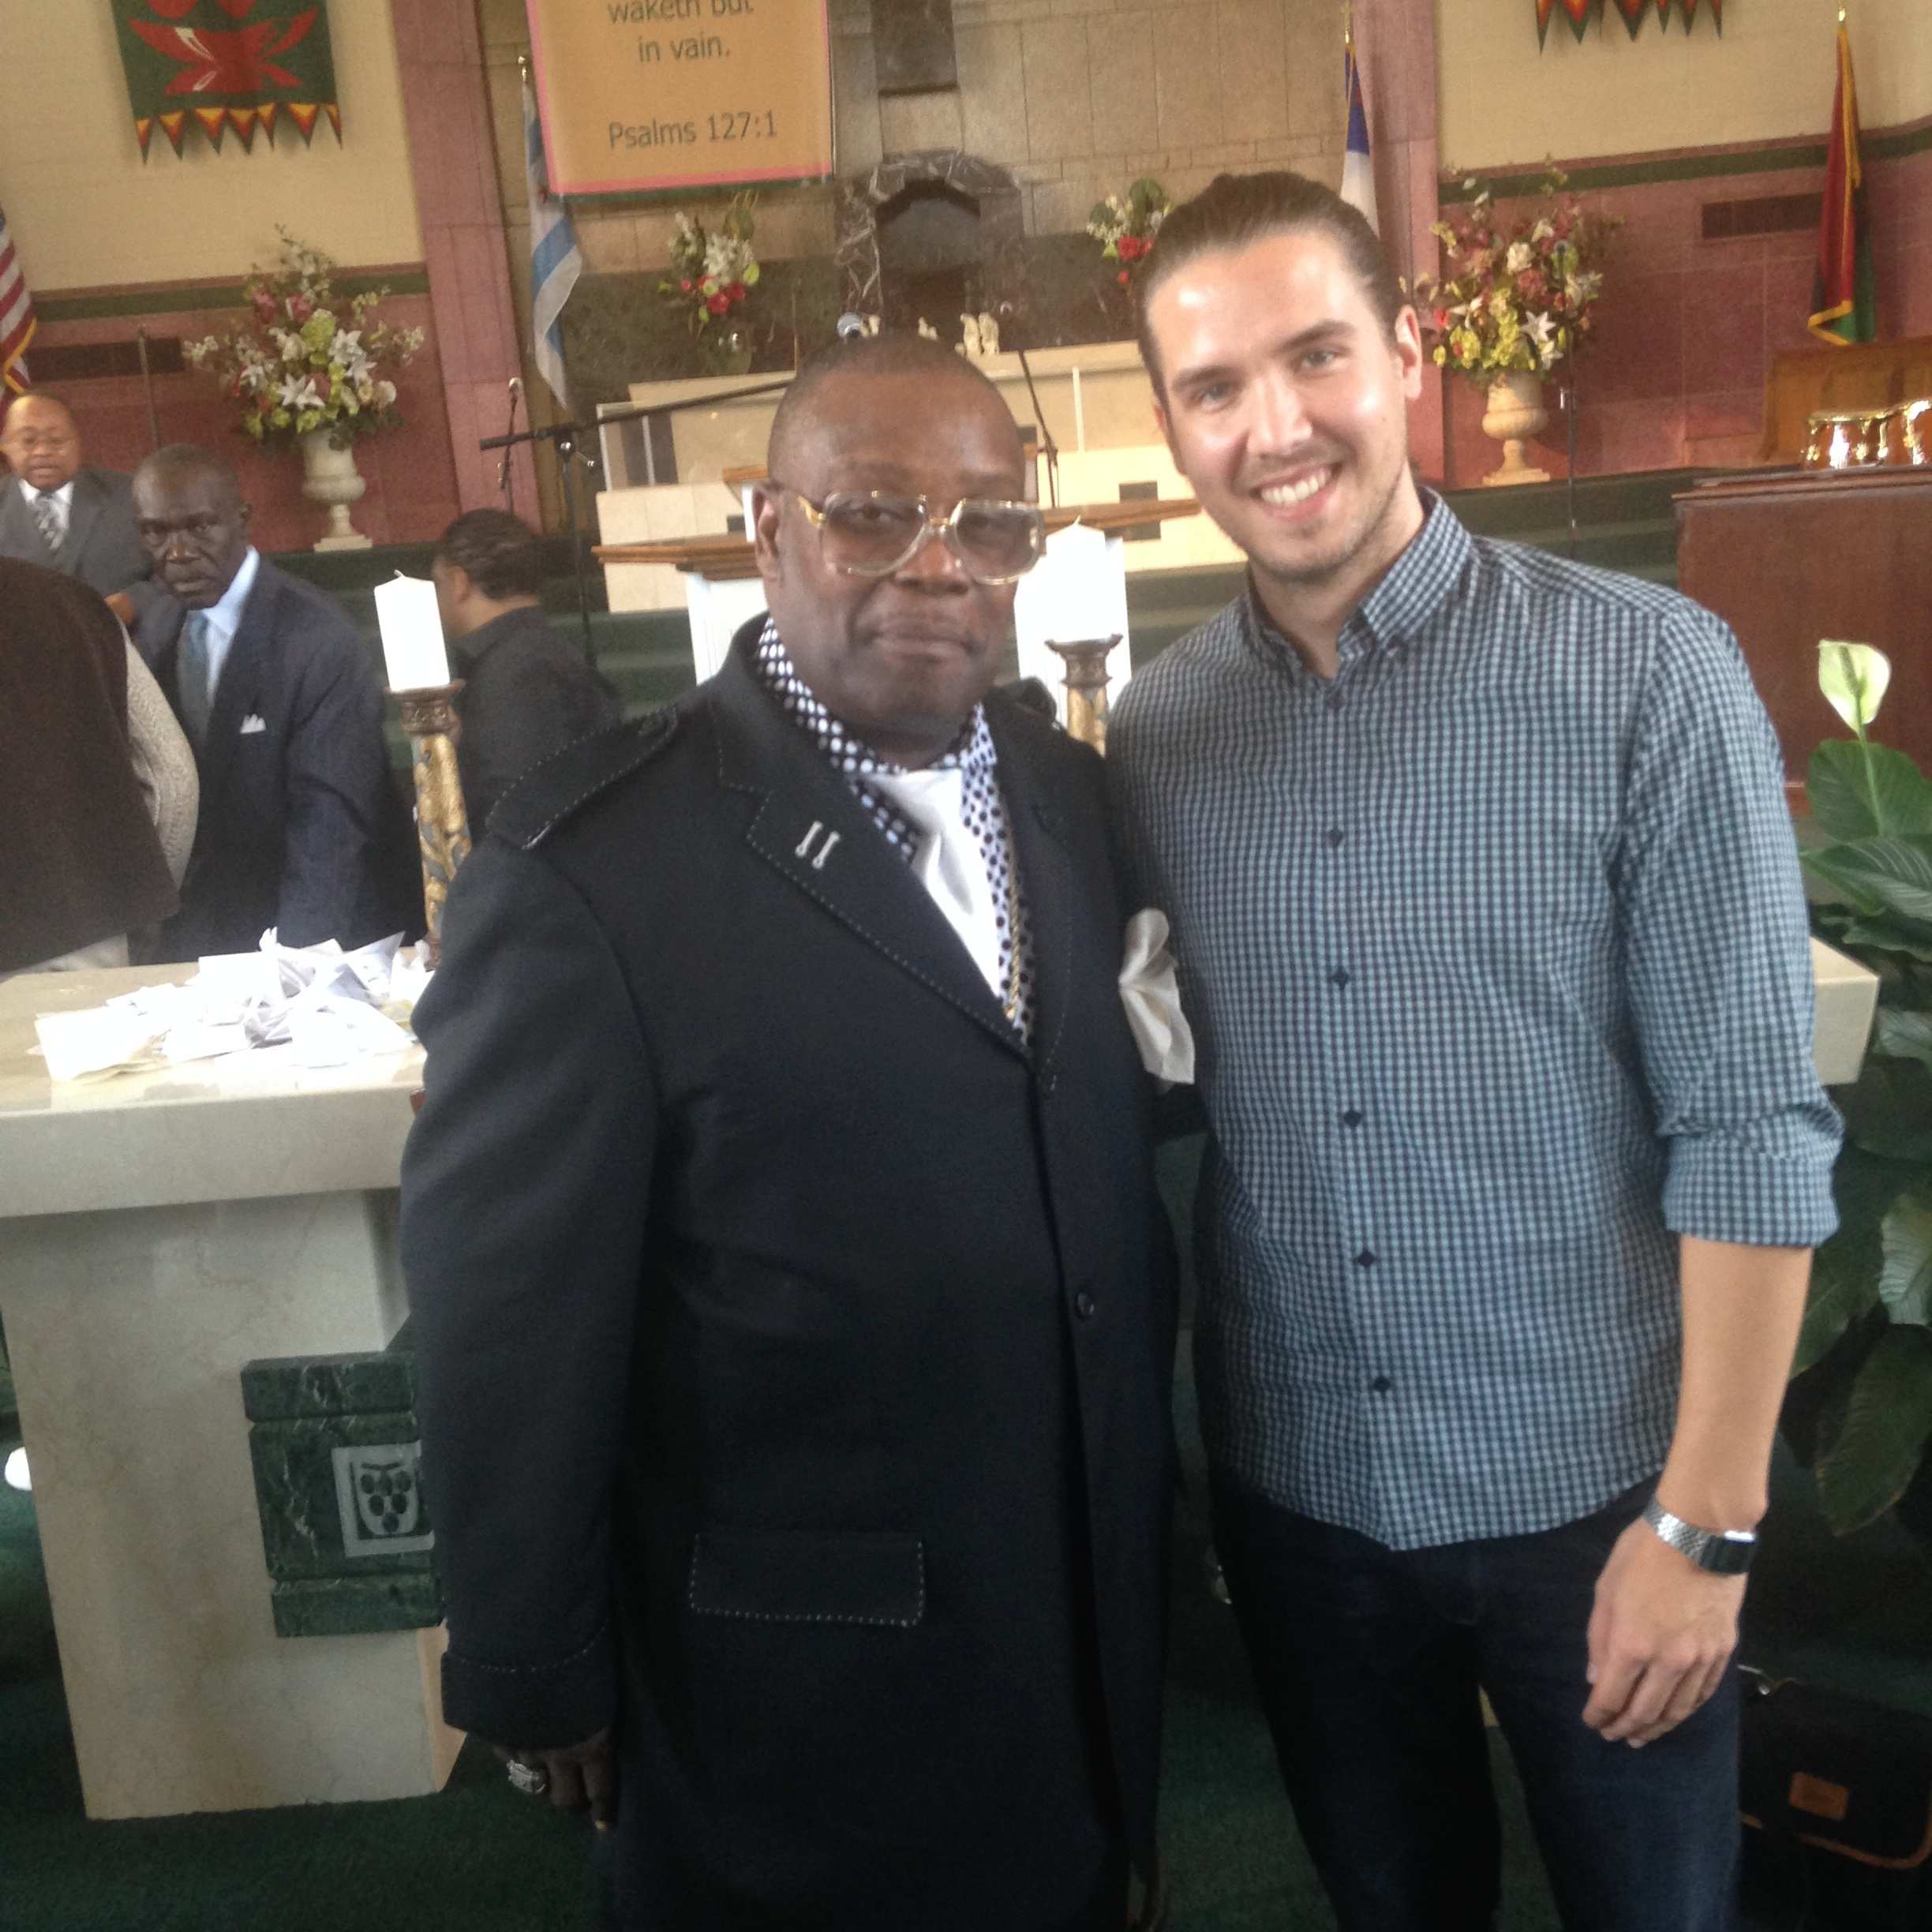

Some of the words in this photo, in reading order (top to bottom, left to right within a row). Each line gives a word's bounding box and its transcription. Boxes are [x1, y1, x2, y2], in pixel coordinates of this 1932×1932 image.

[607, 0, 702, 24] waketh
[637, 36, 661, 62] in
[670, 31, 732, 60] vain.
[608, 118, 697, 150] Psalms
[707, 109, 778, 141] 127:1
